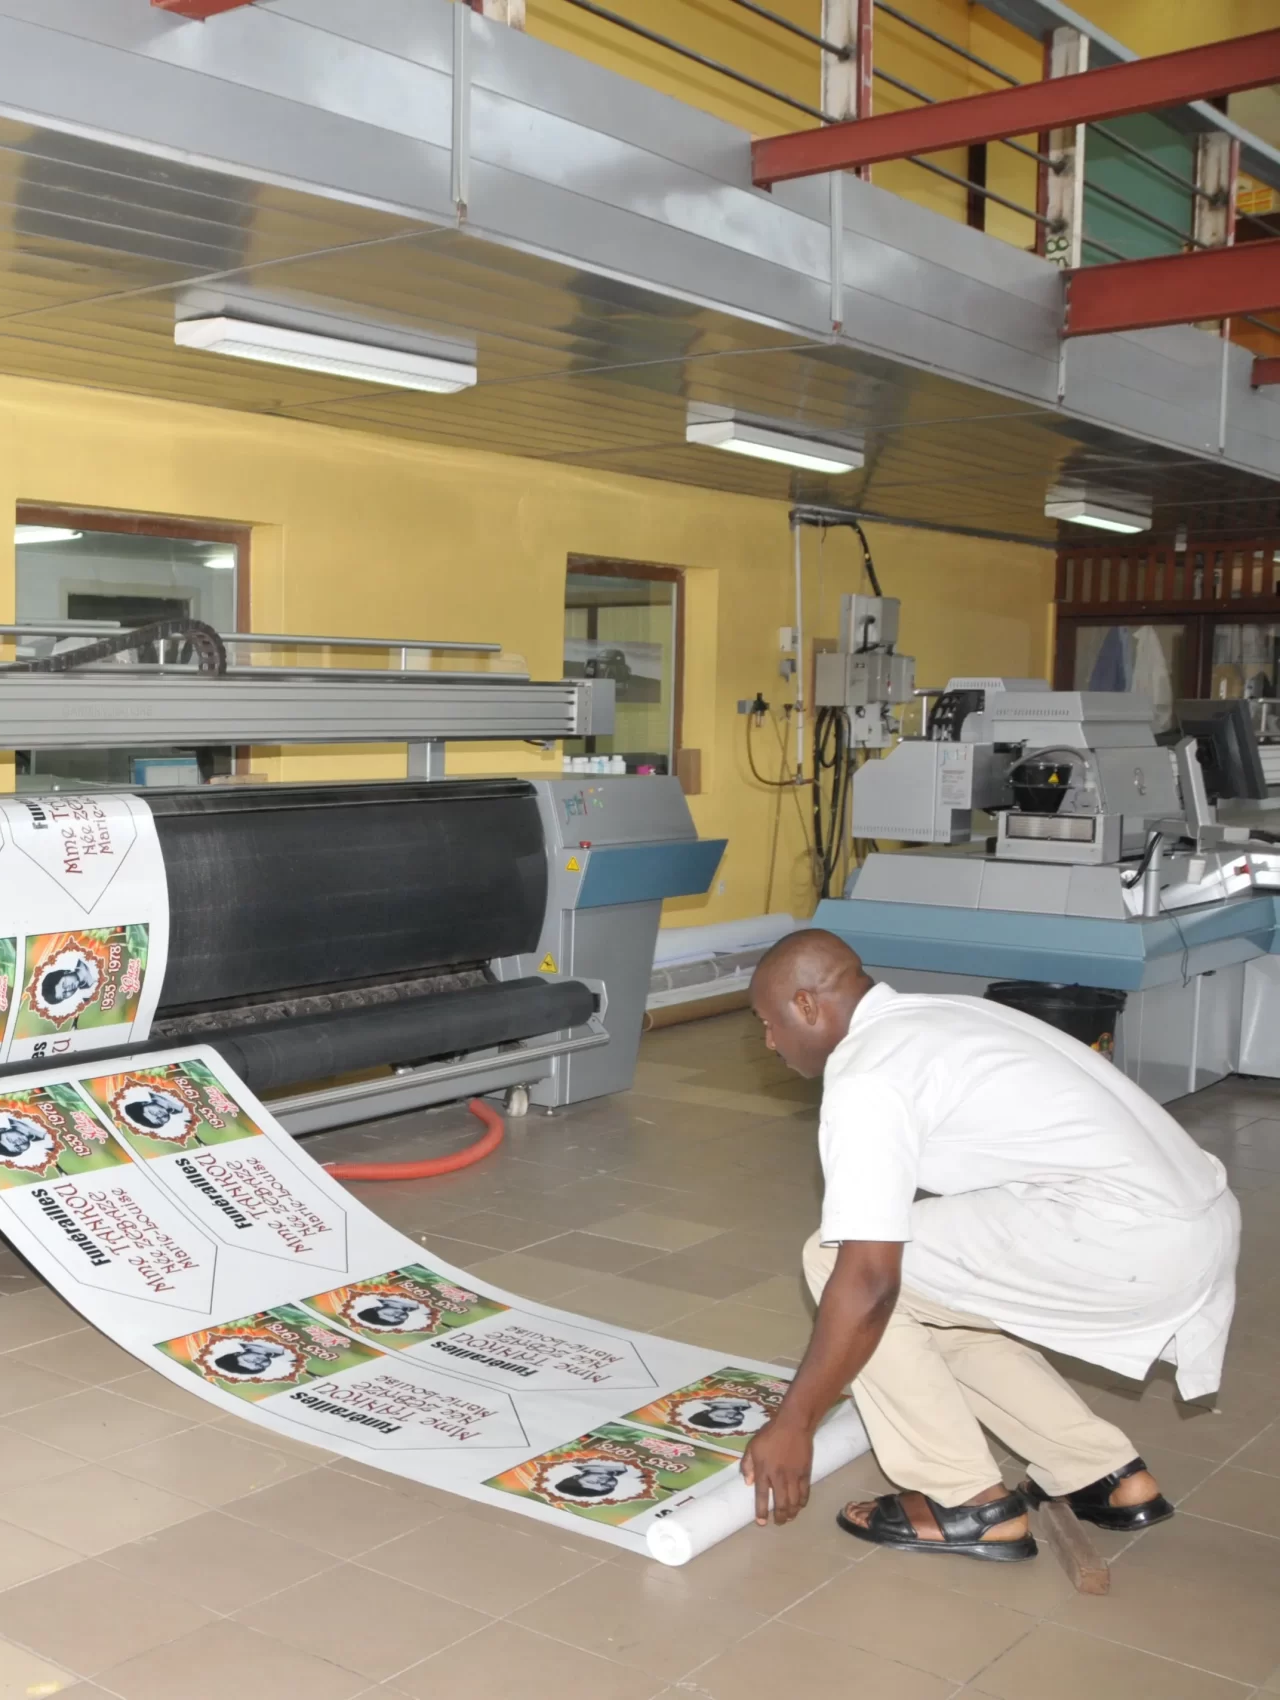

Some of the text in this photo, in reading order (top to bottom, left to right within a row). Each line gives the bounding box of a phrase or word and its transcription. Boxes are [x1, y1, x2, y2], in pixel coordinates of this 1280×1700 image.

[61, 828, 83, 874] Mme
[80, 825, 97, 855] Née
[108, 944, 121, 974] 1978
[101, 984, 116, 1011] 1935
[38, 1102, 66, 1127] 1978
[175, 1157, 254, 1230] Funérailles
[194, 1152, 314, 1254] Mme TANKOU
[246, 1156, 333, 1233] Marie-Louise
[31, 1188, 112, 1267] Funérailles
[53, 1182, 176, 1293] Mme TANKOU
[111, 1187, 200, 1269] Marie-Louise
[287, 1214, 317, 1237] Née
[150, 1249, 182, 1274] Née
[430, 1340, 539, 1378] Funérailles
[289, 1391, 403, 1435] Funérailles
[311, 1381, 482, 1442] Mme TANKOU
